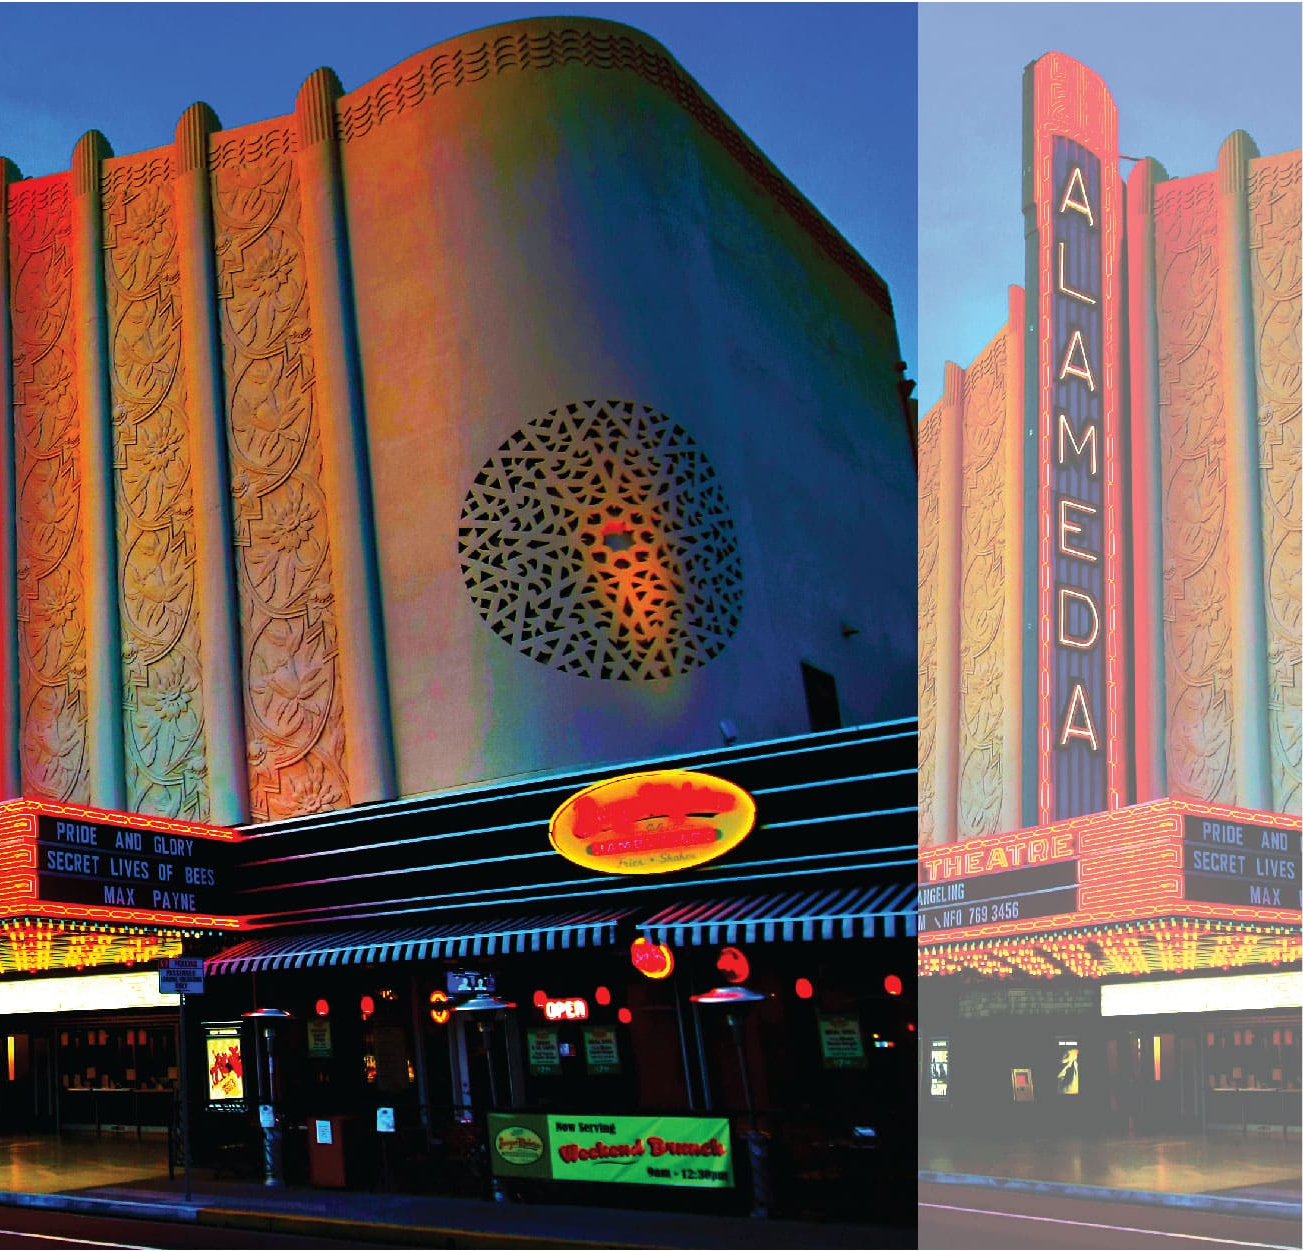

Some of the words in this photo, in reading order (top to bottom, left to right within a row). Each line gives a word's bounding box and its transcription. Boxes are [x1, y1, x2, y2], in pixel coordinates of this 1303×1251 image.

[1057, 166, 1099, 751] ALAMEDA
[56, 821, 97, 846] PRIDE
[115, 831, 142, 851] AND
[153, 835, 194, 857] GLORY
[1202, 821, 1243, 846] PRIDE
[1261, 831, 1288, 851] AND
[47, 850, 99, 874] SECRET
[110, 857, 149, 879] LIVES
[158, 863, 173, 881] OF
[185, 866, 215, 886] BEES
[925, 833, 1074, 881] THEATRE
[1193, 850, 1245, 874] SECRET
[1256, 857, 1295, 879] LIVES
[104, 885, 136, 906] MAX
[152, 889, 197, 911] PAYNE
[918, 883, 965, 906] ANGELING
[1250, 885, 1282, 906] MAX
[969, 905, 988, 925] 769
[991, 901, 1019, 921] 3456
[545, 1000, 586, 1019] OPEN
[555, 1121, 576, 1133] Now
[578, 1121, 617, 1135] Serving
[558, 1137, 646, 1164] Weekend
[646, 1135, 727, 1157] Brunch
